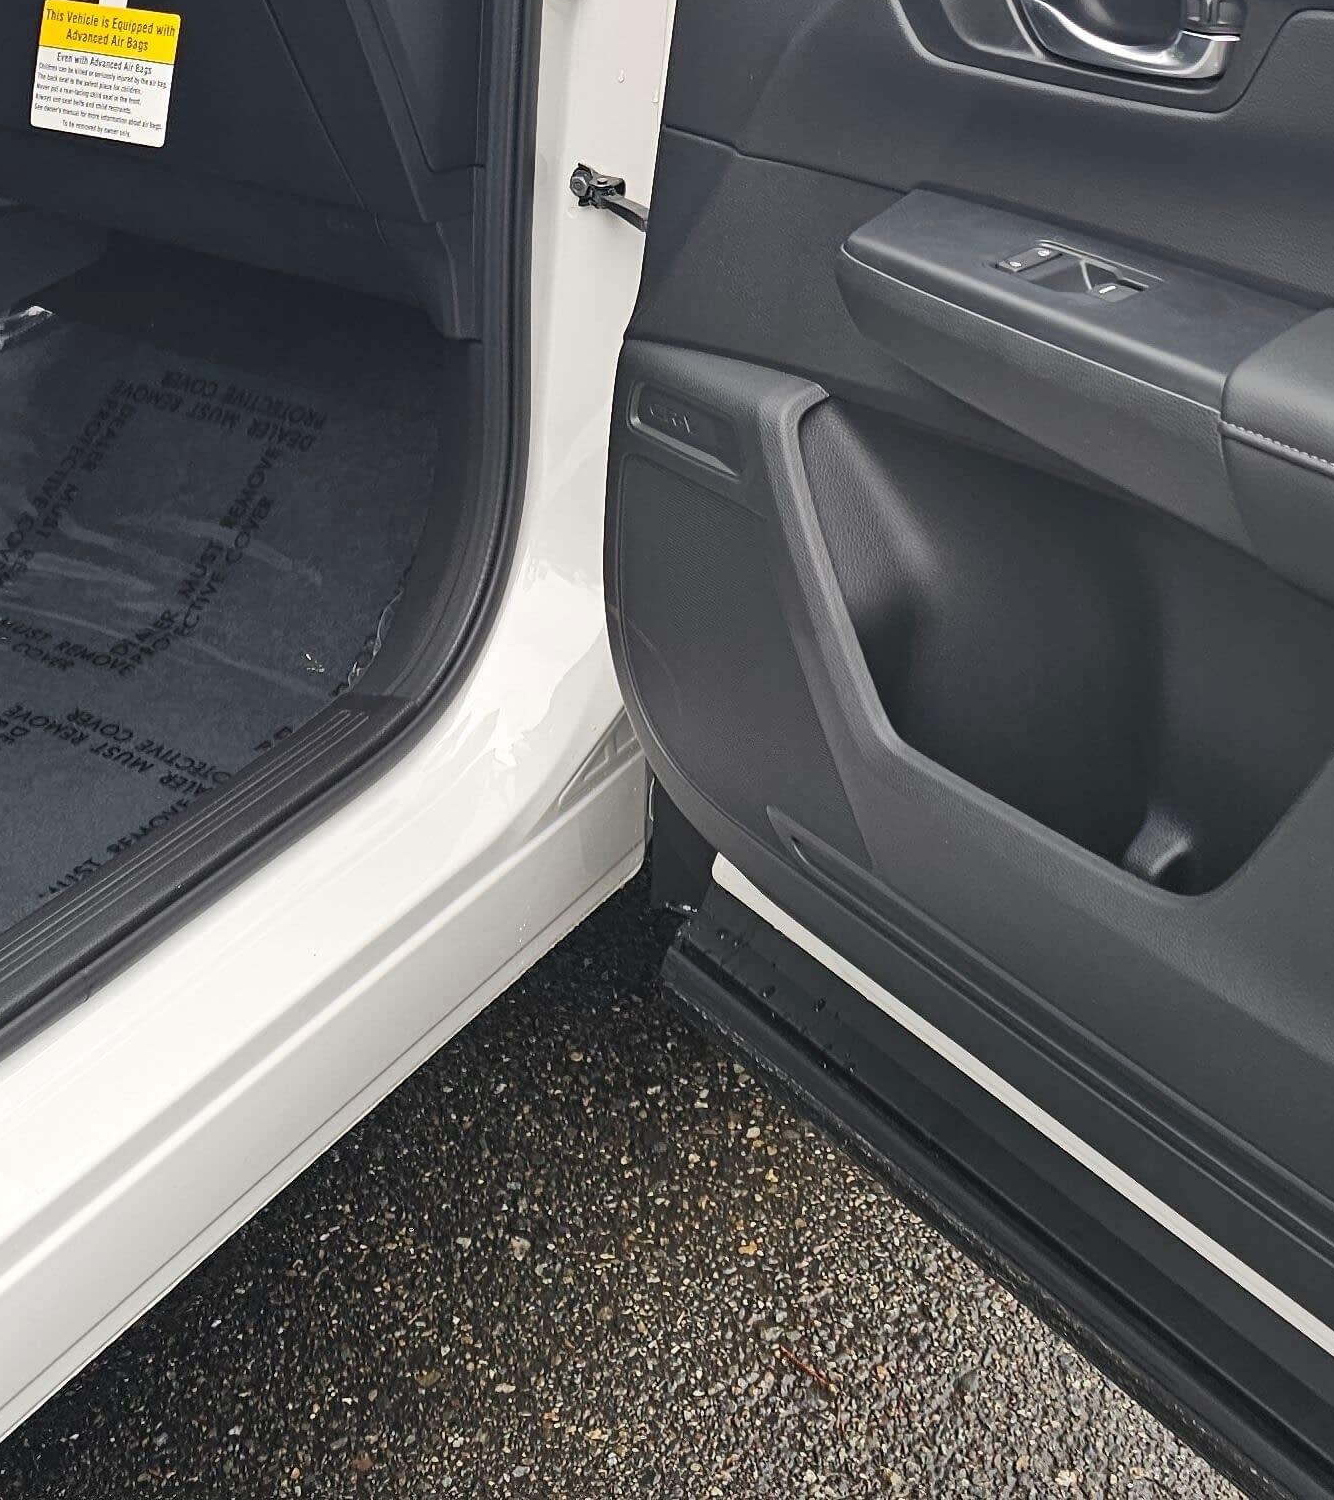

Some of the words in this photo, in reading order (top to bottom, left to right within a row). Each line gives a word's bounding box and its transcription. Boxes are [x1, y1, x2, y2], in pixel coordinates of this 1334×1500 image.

[46, 8, 64, 22] This
[67, 10, 99, 27] Vehicle
[101, 15, 110, 29] is
[112, 17, 154, 35] Equipped
[156, 23, 175, 37] with
[66, 28, 109, 45] Advanced
[111, 34, 125, 47] Air
[126, 36, 149, 53] Bags
[56, 51, 73, 63] Even
[73, 55, 89, 65] with
[89, 56, 123, 71] Advanced
[123, 61, 134, 72] Air
[135, 63, 153, 76] Bags
[53, 640, 136, 678] REMOVE
[4, 703, 91, 746] REMOVE
[66, 706, 134, 744] COVER
[88, 742, 155, 774] MUST
[134, 738, 234, 788] OTECTIVE
[158, 770, 216, 799] ALER
